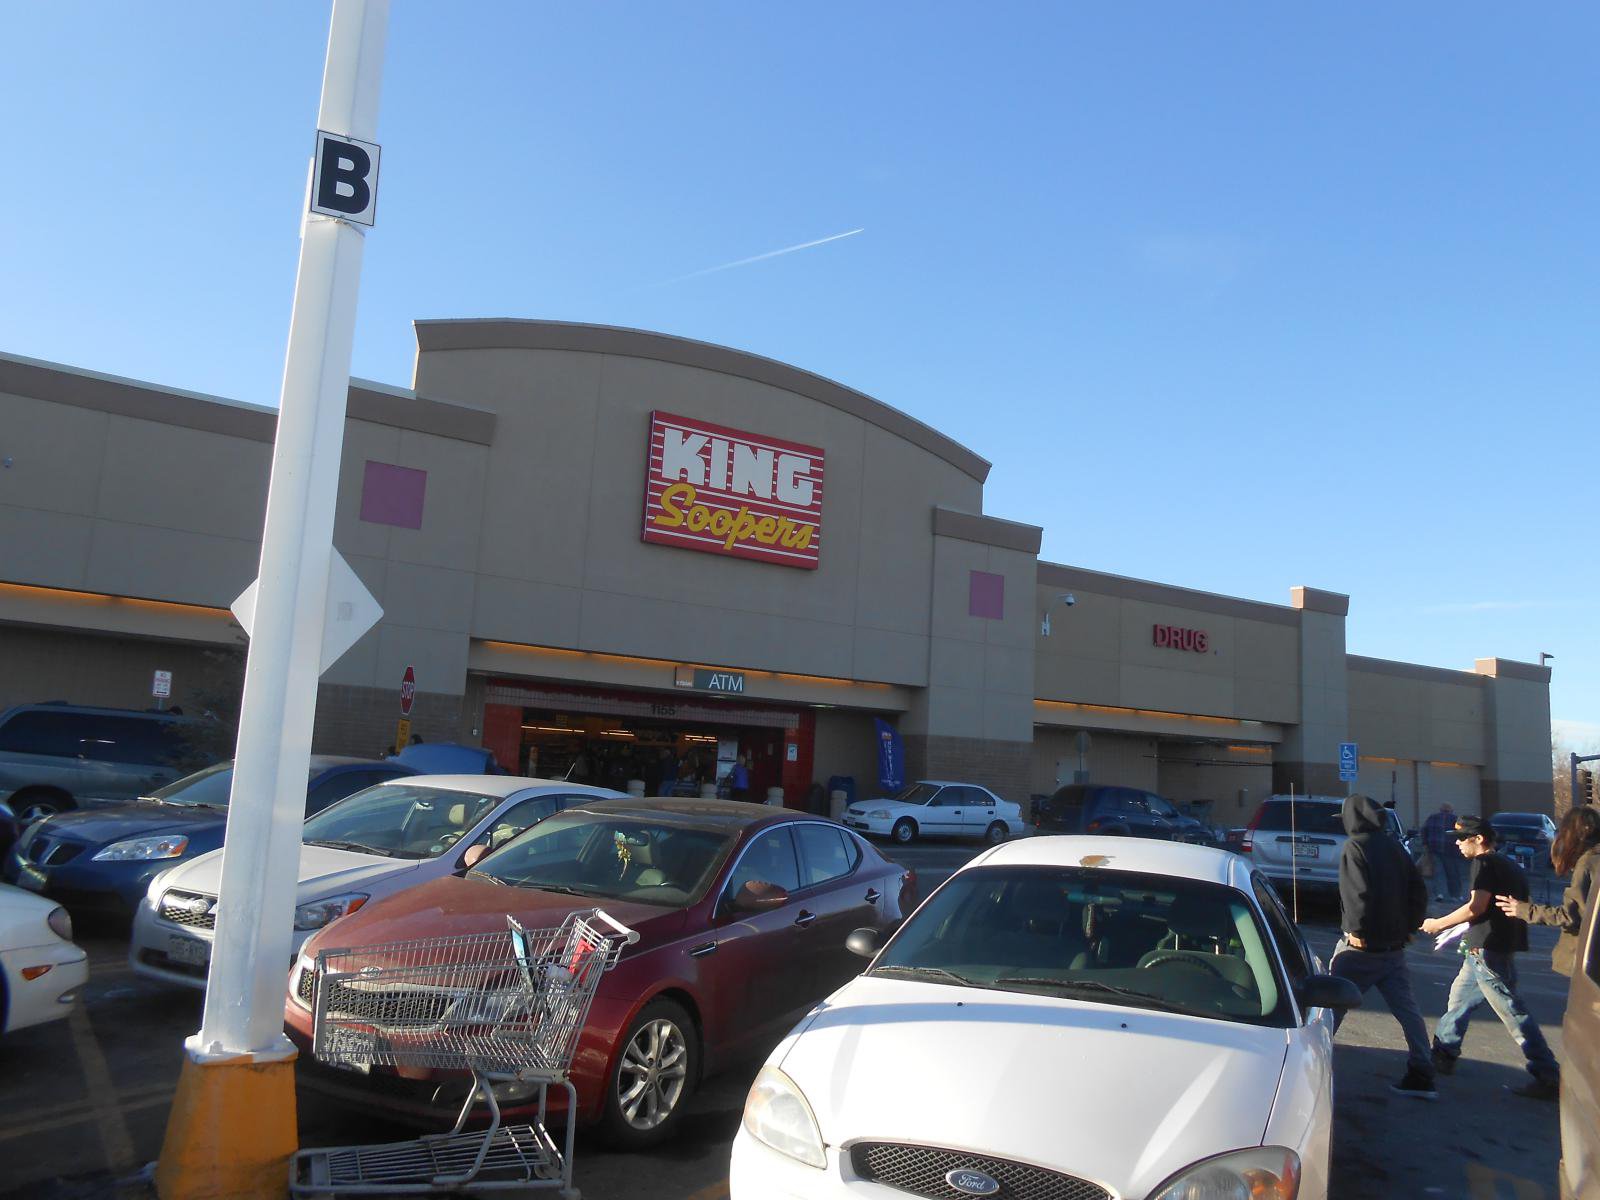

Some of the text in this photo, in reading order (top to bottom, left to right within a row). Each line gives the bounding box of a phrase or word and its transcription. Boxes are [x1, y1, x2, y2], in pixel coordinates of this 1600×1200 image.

[318, 138, 371, 214] B
[661, 427, 814, 507] KING
[653, 483, 814, 551] Soopers
[1152, 623, 1209, 653] DRUG
[401, 681, 415, 699] STOP
[708, 673, 743, 692] ATM
[958, 1173, 986, 1191] Ford
